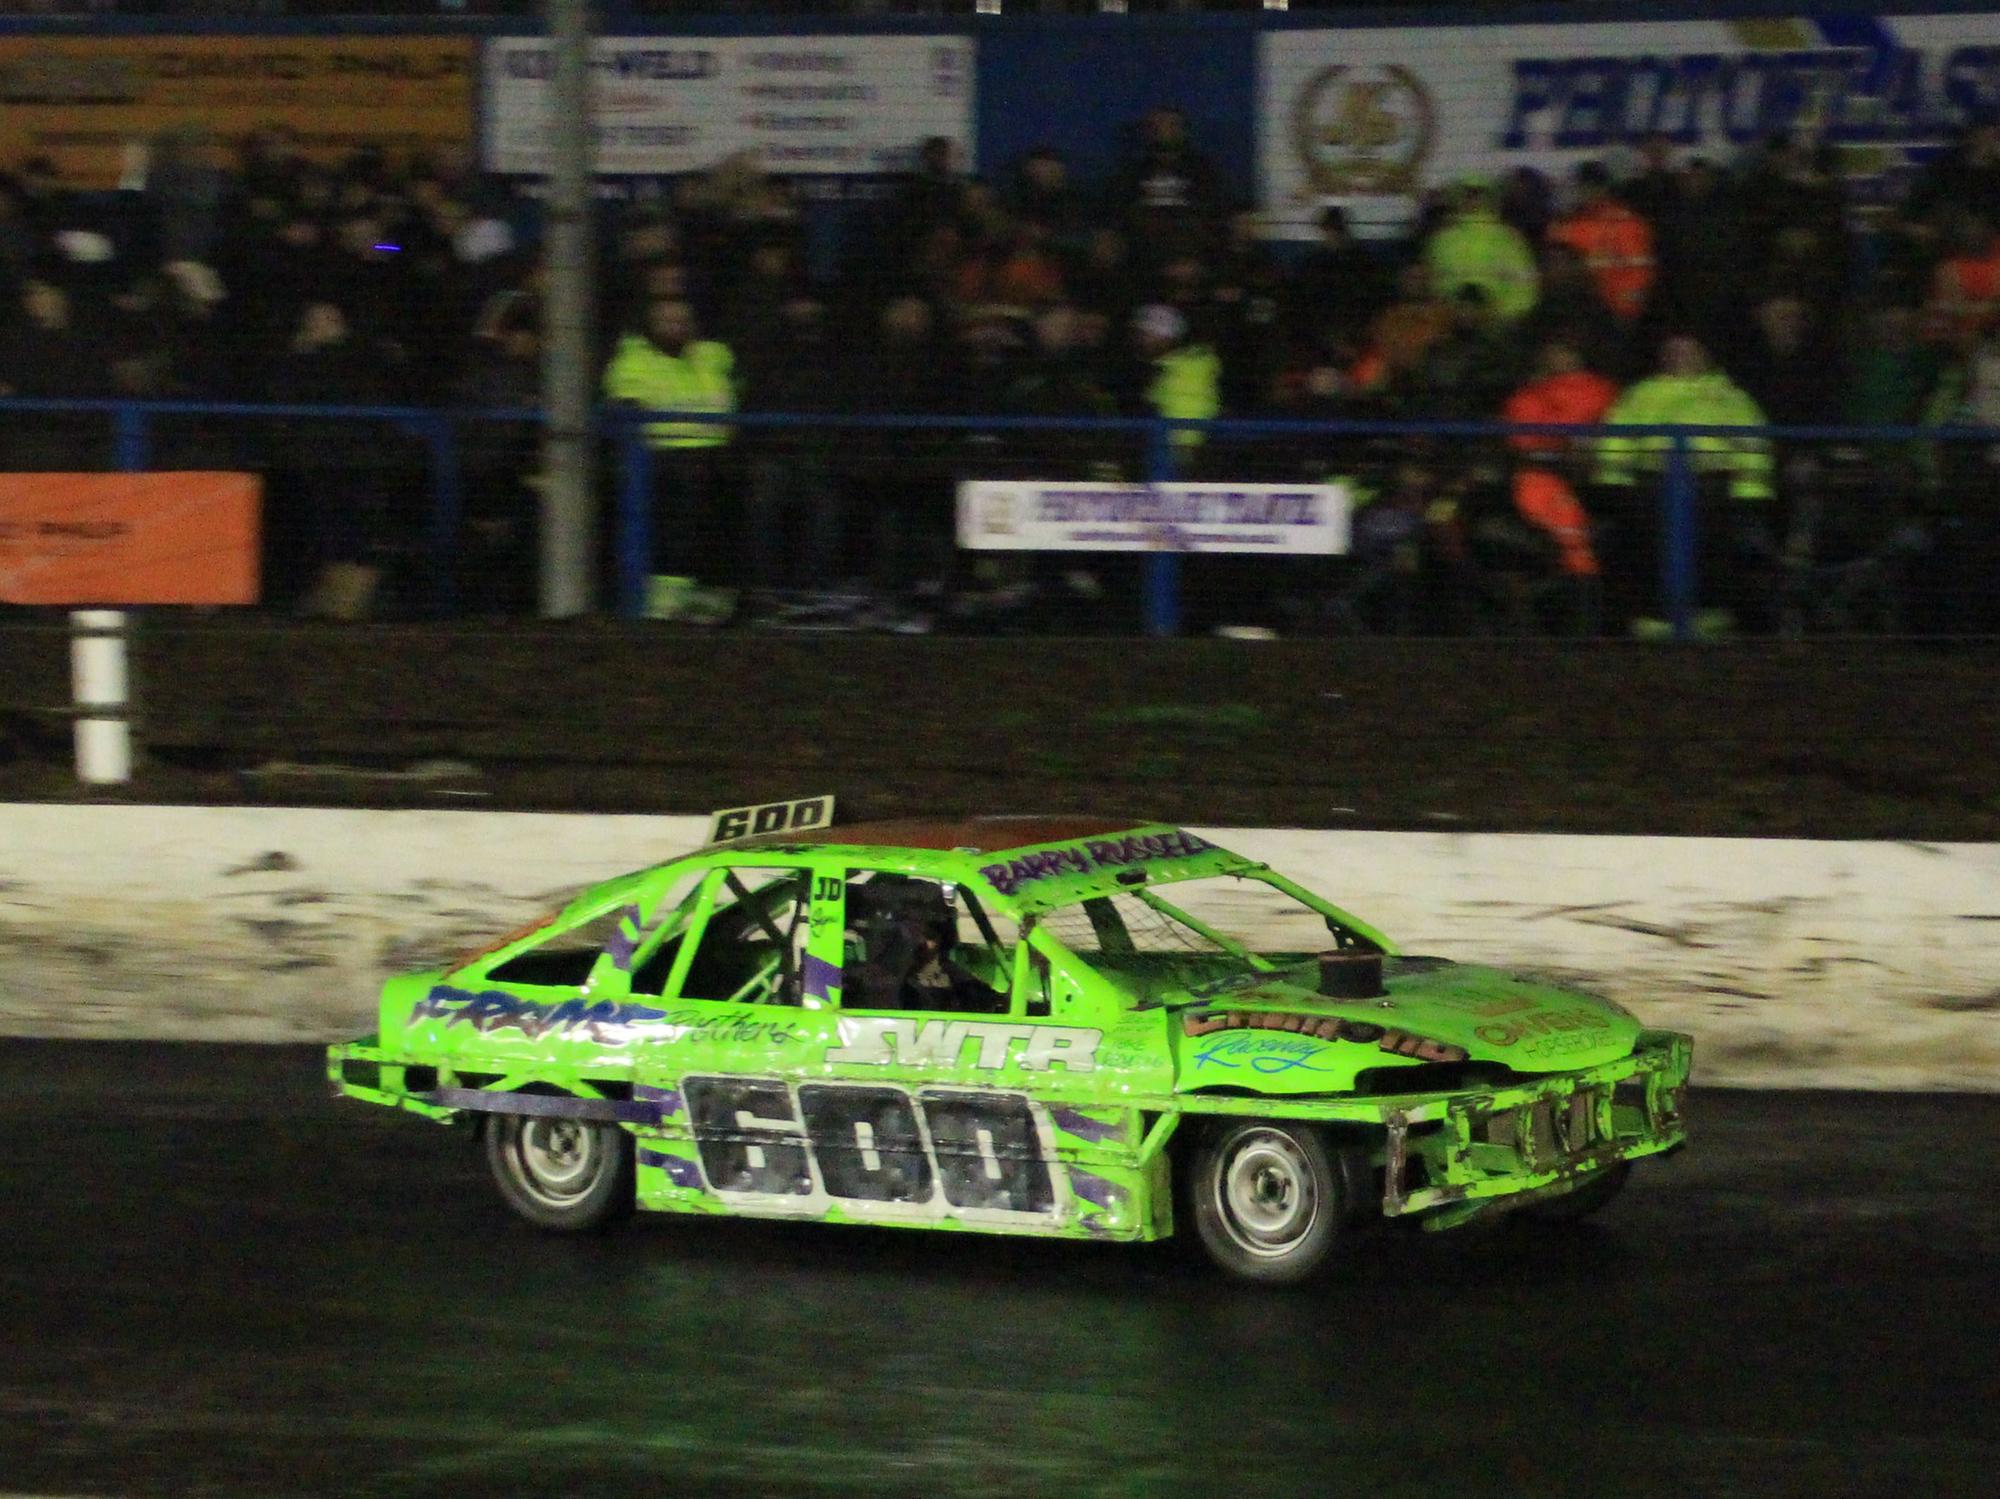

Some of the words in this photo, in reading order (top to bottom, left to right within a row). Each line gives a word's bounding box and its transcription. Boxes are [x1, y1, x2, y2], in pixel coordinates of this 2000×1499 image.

[713, 799, 826, 842] 600
[814, 876, 841, 901] JD
[825, 1017, 1104, 1073] SWTR
[681, 1076, 1056, 1214] 600
